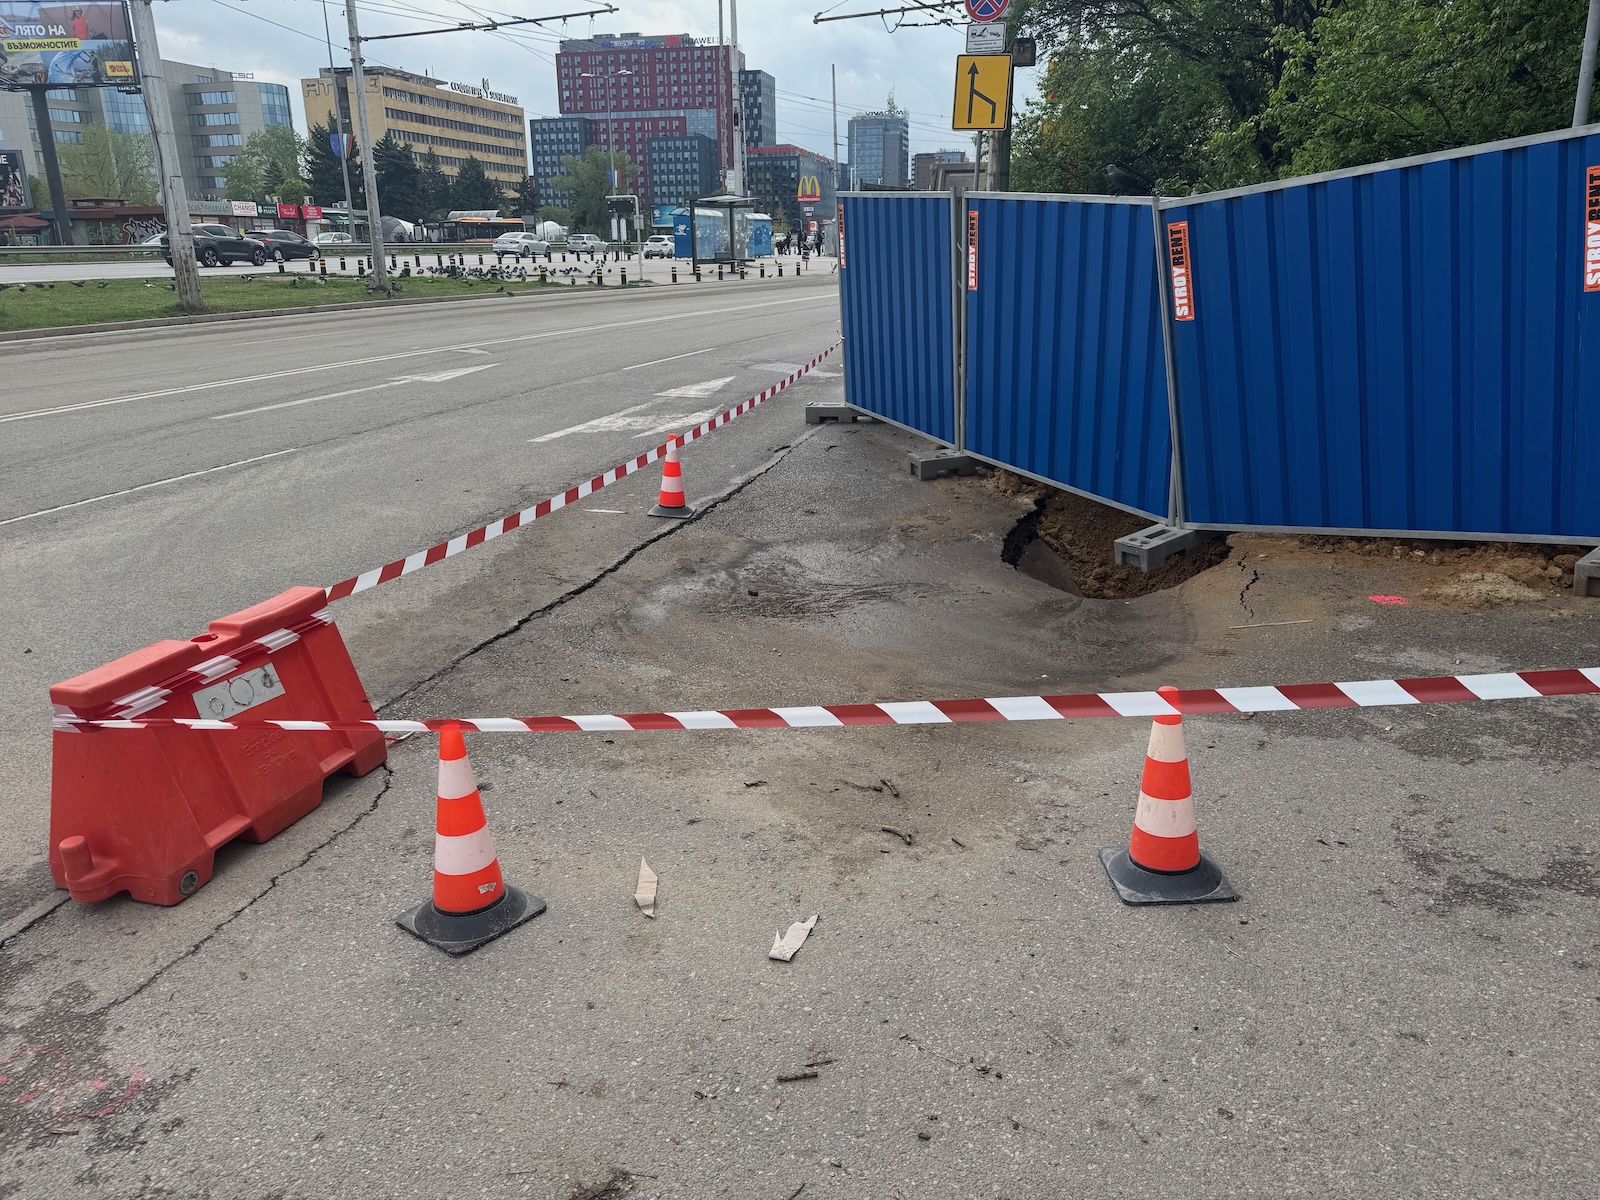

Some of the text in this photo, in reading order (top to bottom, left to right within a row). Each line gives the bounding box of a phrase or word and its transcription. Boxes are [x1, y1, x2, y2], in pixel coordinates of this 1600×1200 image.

[15, 25, 66, 36] ЛЯТО НА
[7, 40, 78, 50] ВЪЗМОЖНОСТИТЕ
[681, 36, 715, 45] HUAWEI
[233, 204, 256, 212] CHANGE
